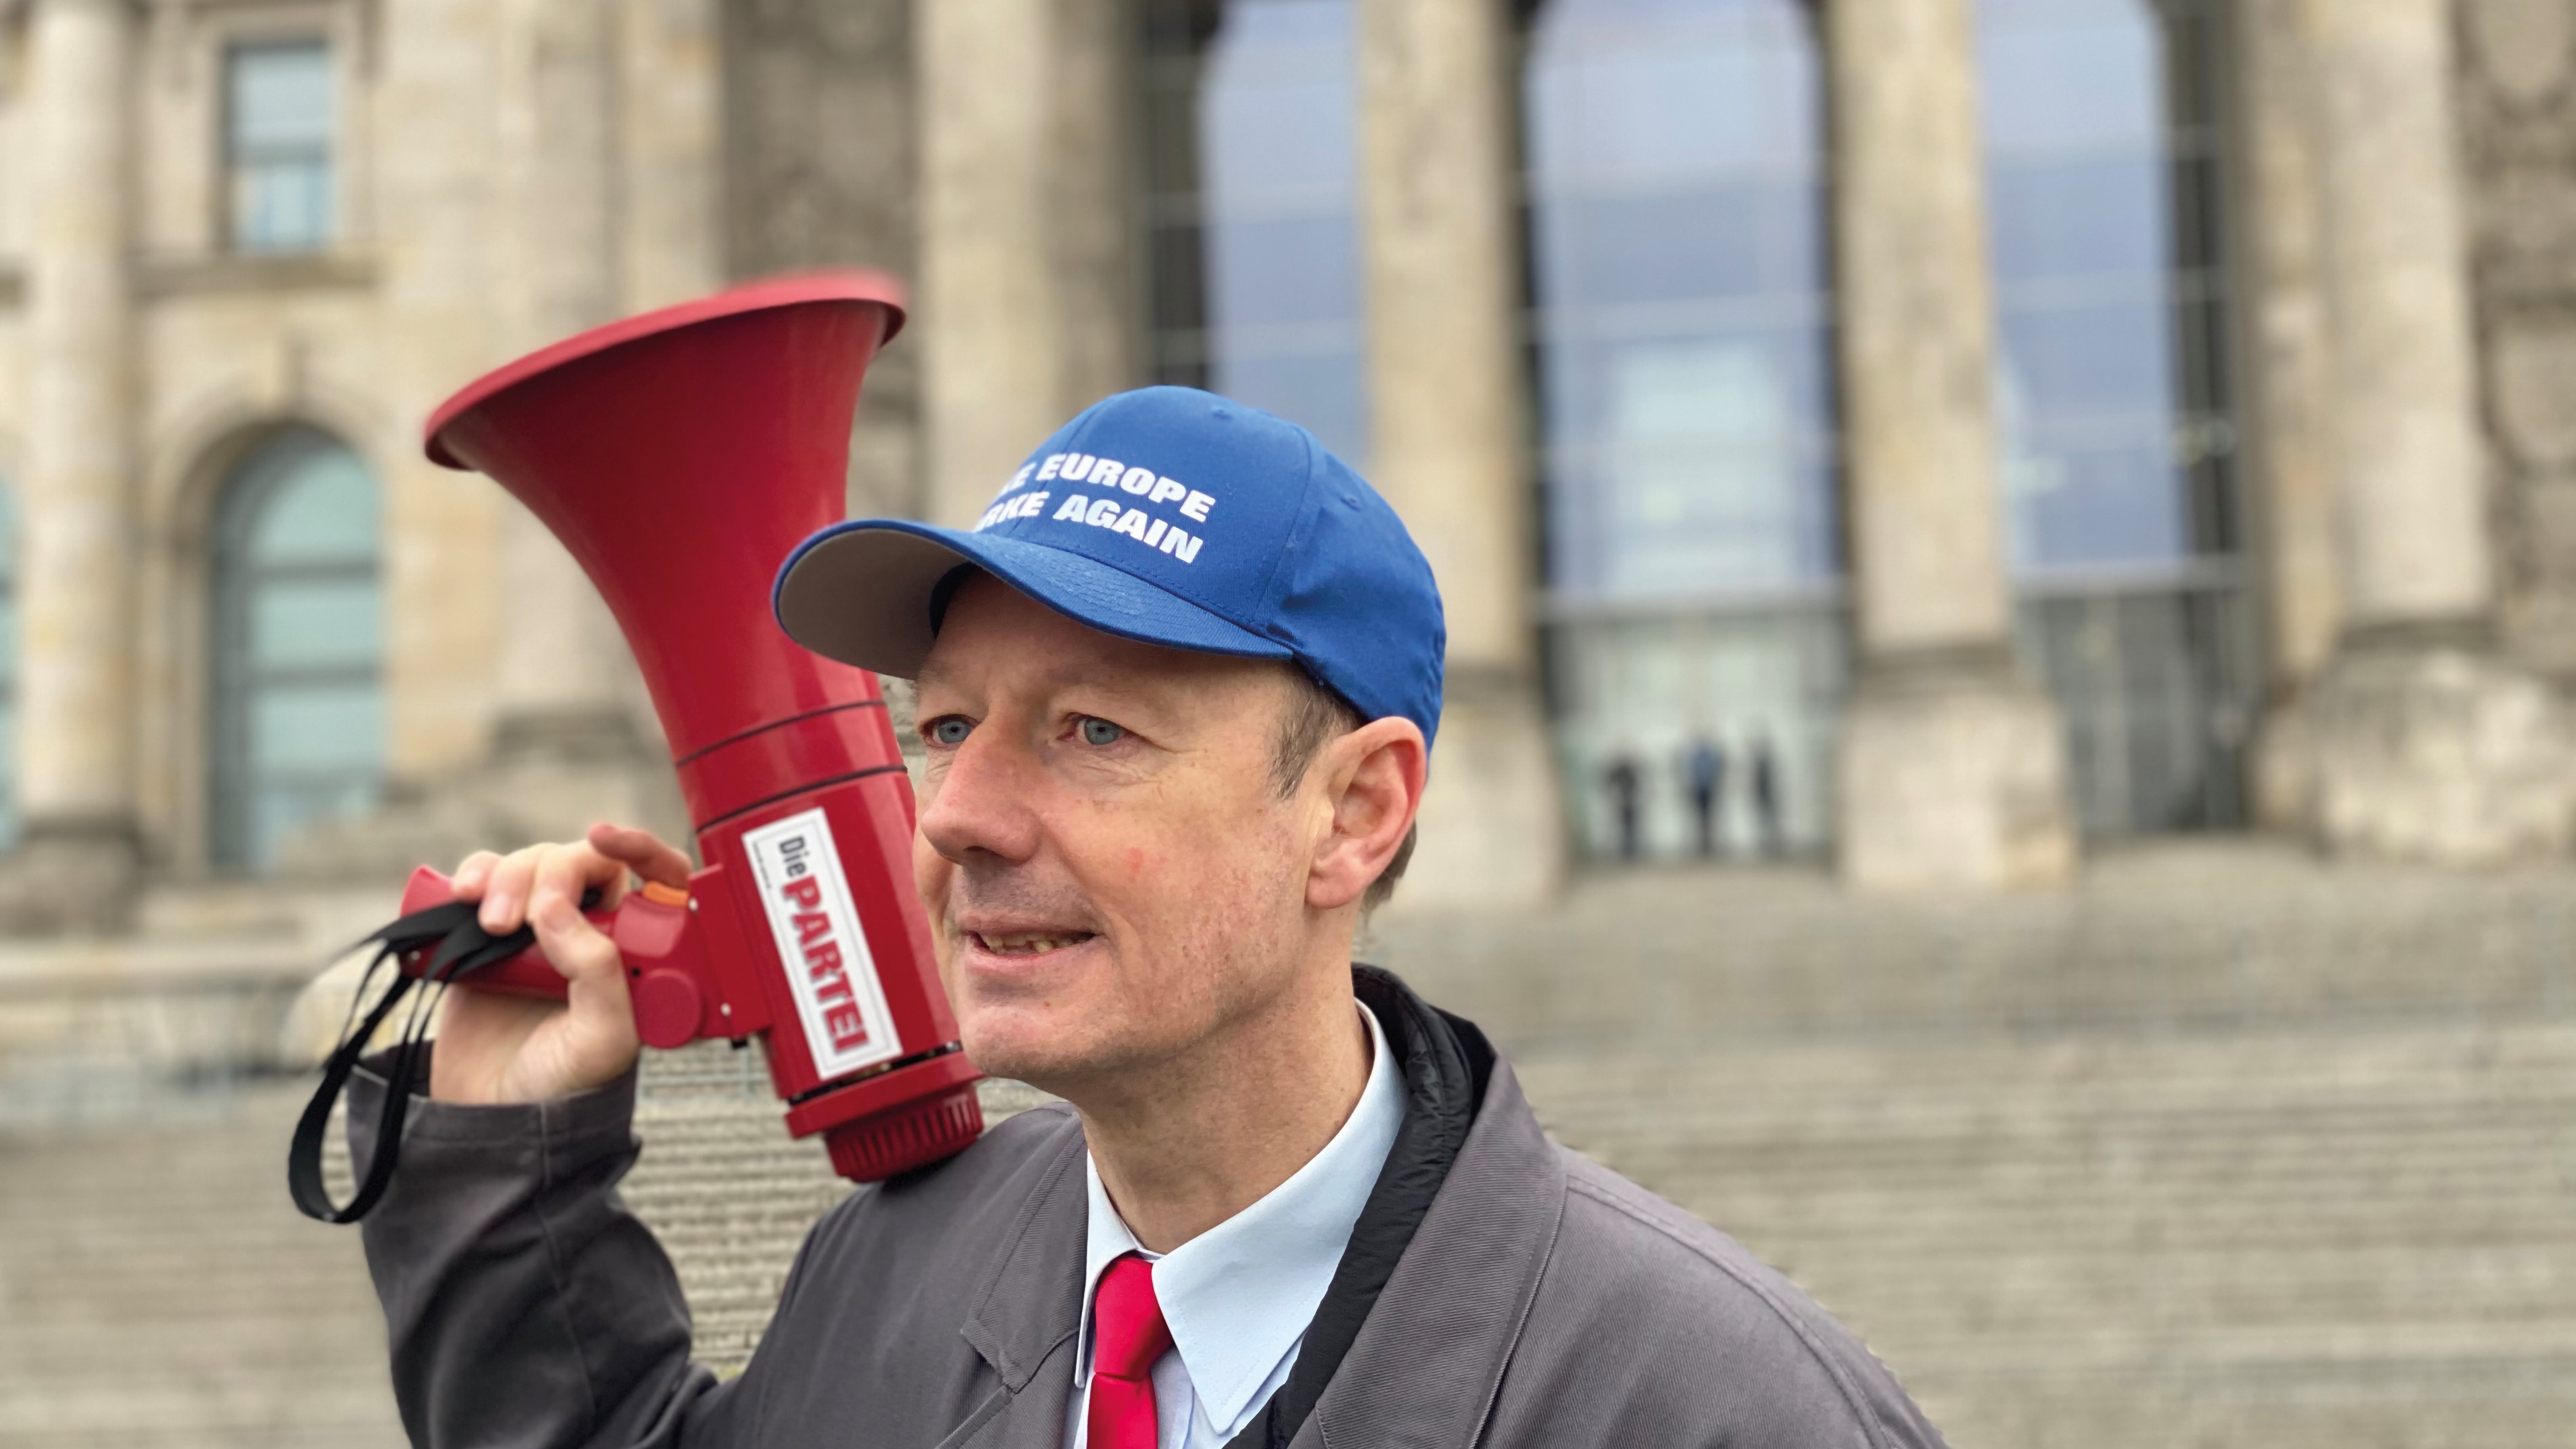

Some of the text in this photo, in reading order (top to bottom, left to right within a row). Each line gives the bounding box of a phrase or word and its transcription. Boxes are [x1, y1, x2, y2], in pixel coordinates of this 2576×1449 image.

[1035, 452, 1216, 523] EUROPE
[1053, 494, 1203, 564] AGAIN
[778, 835, 869, 1052] Die PARTEI
